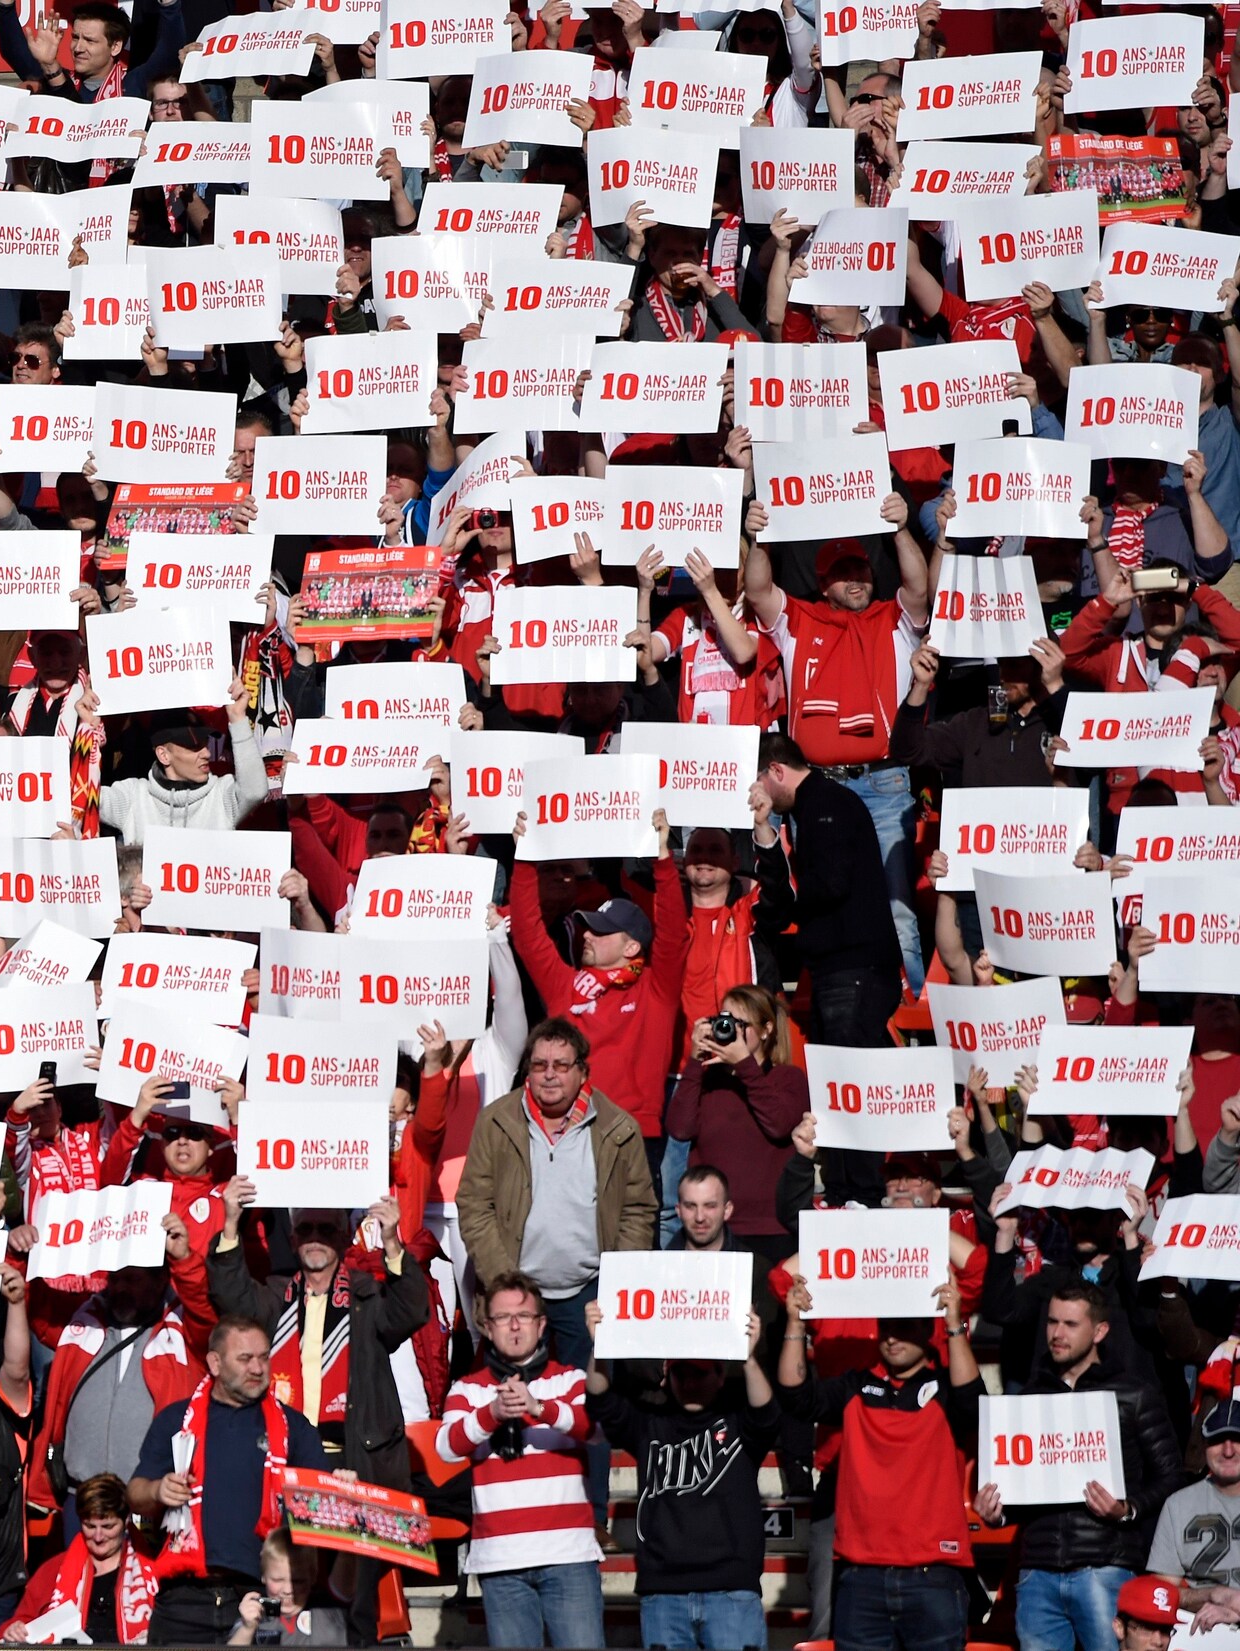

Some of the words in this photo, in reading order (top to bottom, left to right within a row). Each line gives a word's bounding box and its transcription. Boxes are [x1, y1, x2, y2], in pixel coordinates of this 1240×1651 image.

[1083, 49, 1117, 78] 10
[1122, 59, 1184, 75] SUPPORTER
[269, 135, 305, 164] 10
[1080, 139, 1114, 150] STANDARD
[1115, 140, 1124, 148] DE
[310, 152, 373, 165] SUPPORTER
[980, 234, 1016, 264] 10
[1021, 242, 1083, 260] SUPPORTER
[163, 282, 197, 312] 10
[202, 295, 265, 310] SUPPORTER
[148, 487, 184, 496] STANDARD
[185, 487, 194, 496] DE
[266, 470, 301, 500] 10
[305, 487, 367, 499] SUPPORTER
[771, 477, 805, 506] 10
[810, 486, 875, 504] SUPPORTER
[339, 554, 374, 564] STANDARD
[375, 553, 385, 563] DE
[1081, 719, 1121, 740] 10
[1124, 725, 1189, 741] SUPPORTER
[161, 863, 199, 893] 10
[205, 882, 271, 897] SUPPORTER
[828, 1083, 862, 1113] 10
[867, 1100, 935, 1115] SUPPORTER
[256, 1139, 295, 1170] 10
[301, 1157, 368, 1170] SUPPORTER
[819, 1248, 856, 1280] 10
[862, 1265, 928, 1279] SUPPORTER
[995, 1434, 1033, 1466] 10
[1040, 1448, 1106, 1465] SUPPORTER
